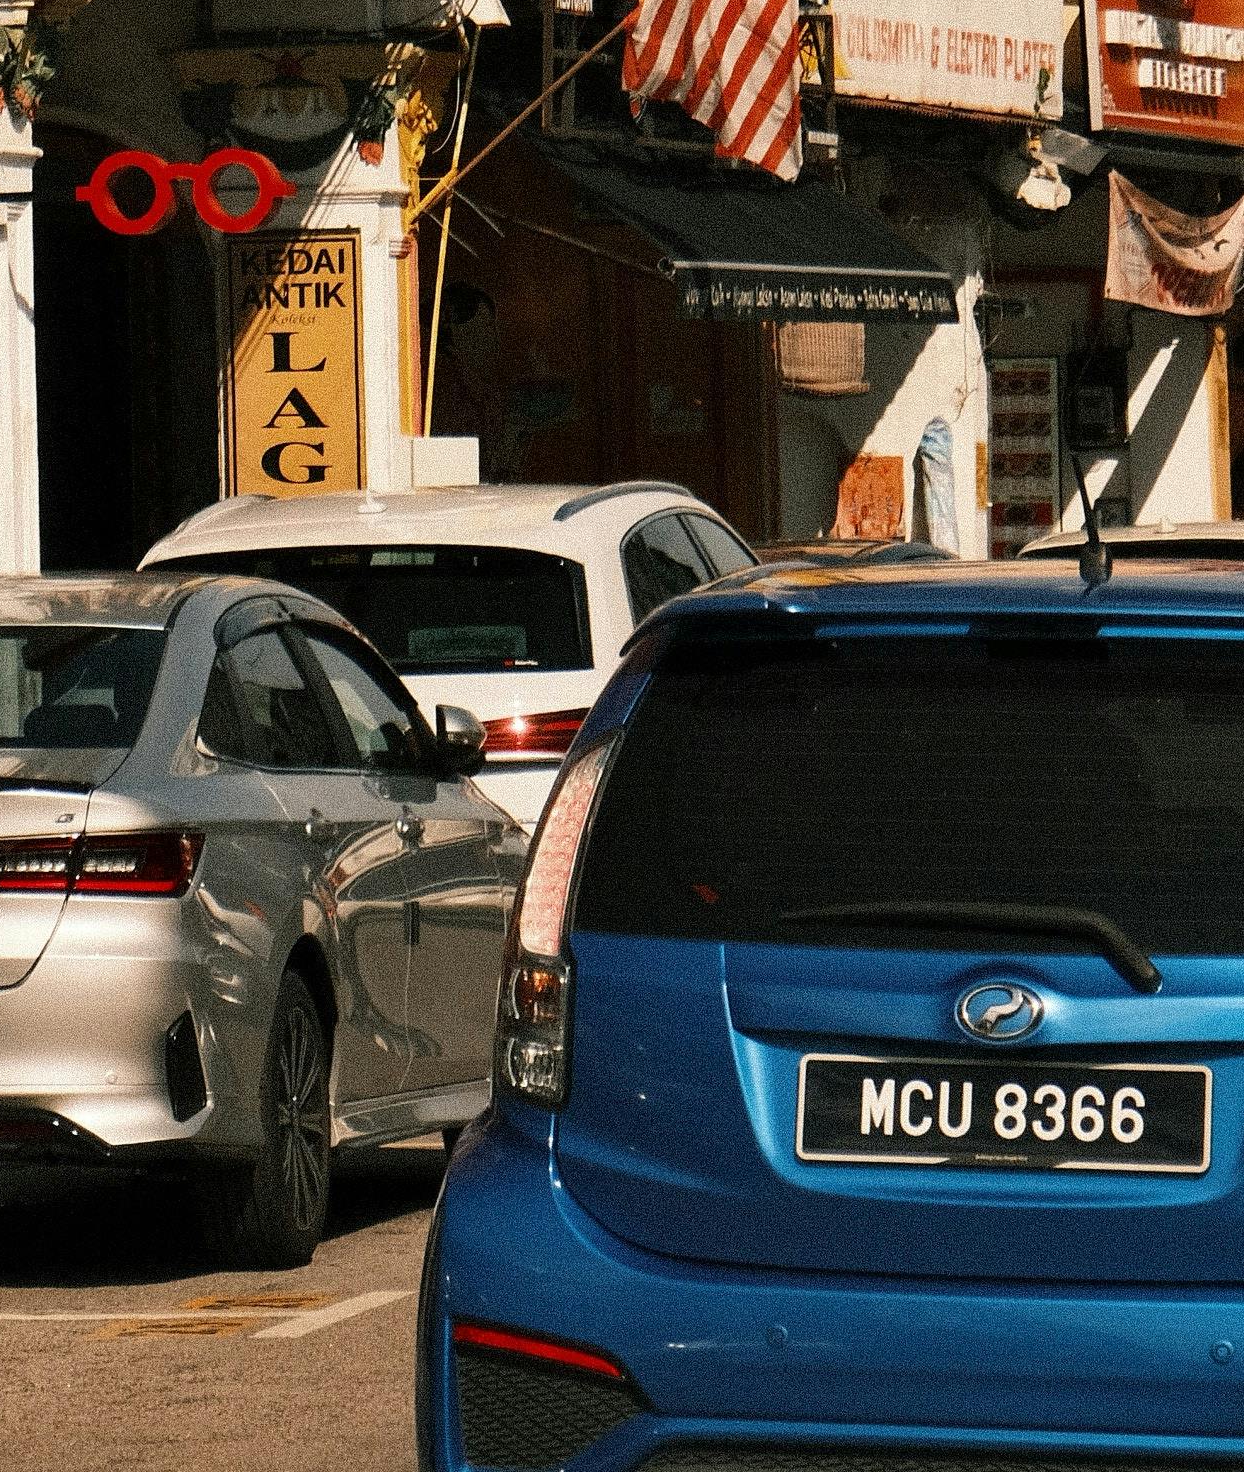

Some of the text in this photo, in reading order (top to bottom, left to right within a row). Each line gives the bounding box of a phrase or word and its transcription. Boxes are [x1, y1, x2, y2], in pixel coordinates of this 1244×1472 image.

[240, 248, 346, 275] KEDAI
[241, 282, 346, 310] ANTIK
[859, 1078, 1147, 1145] MCU 8366
